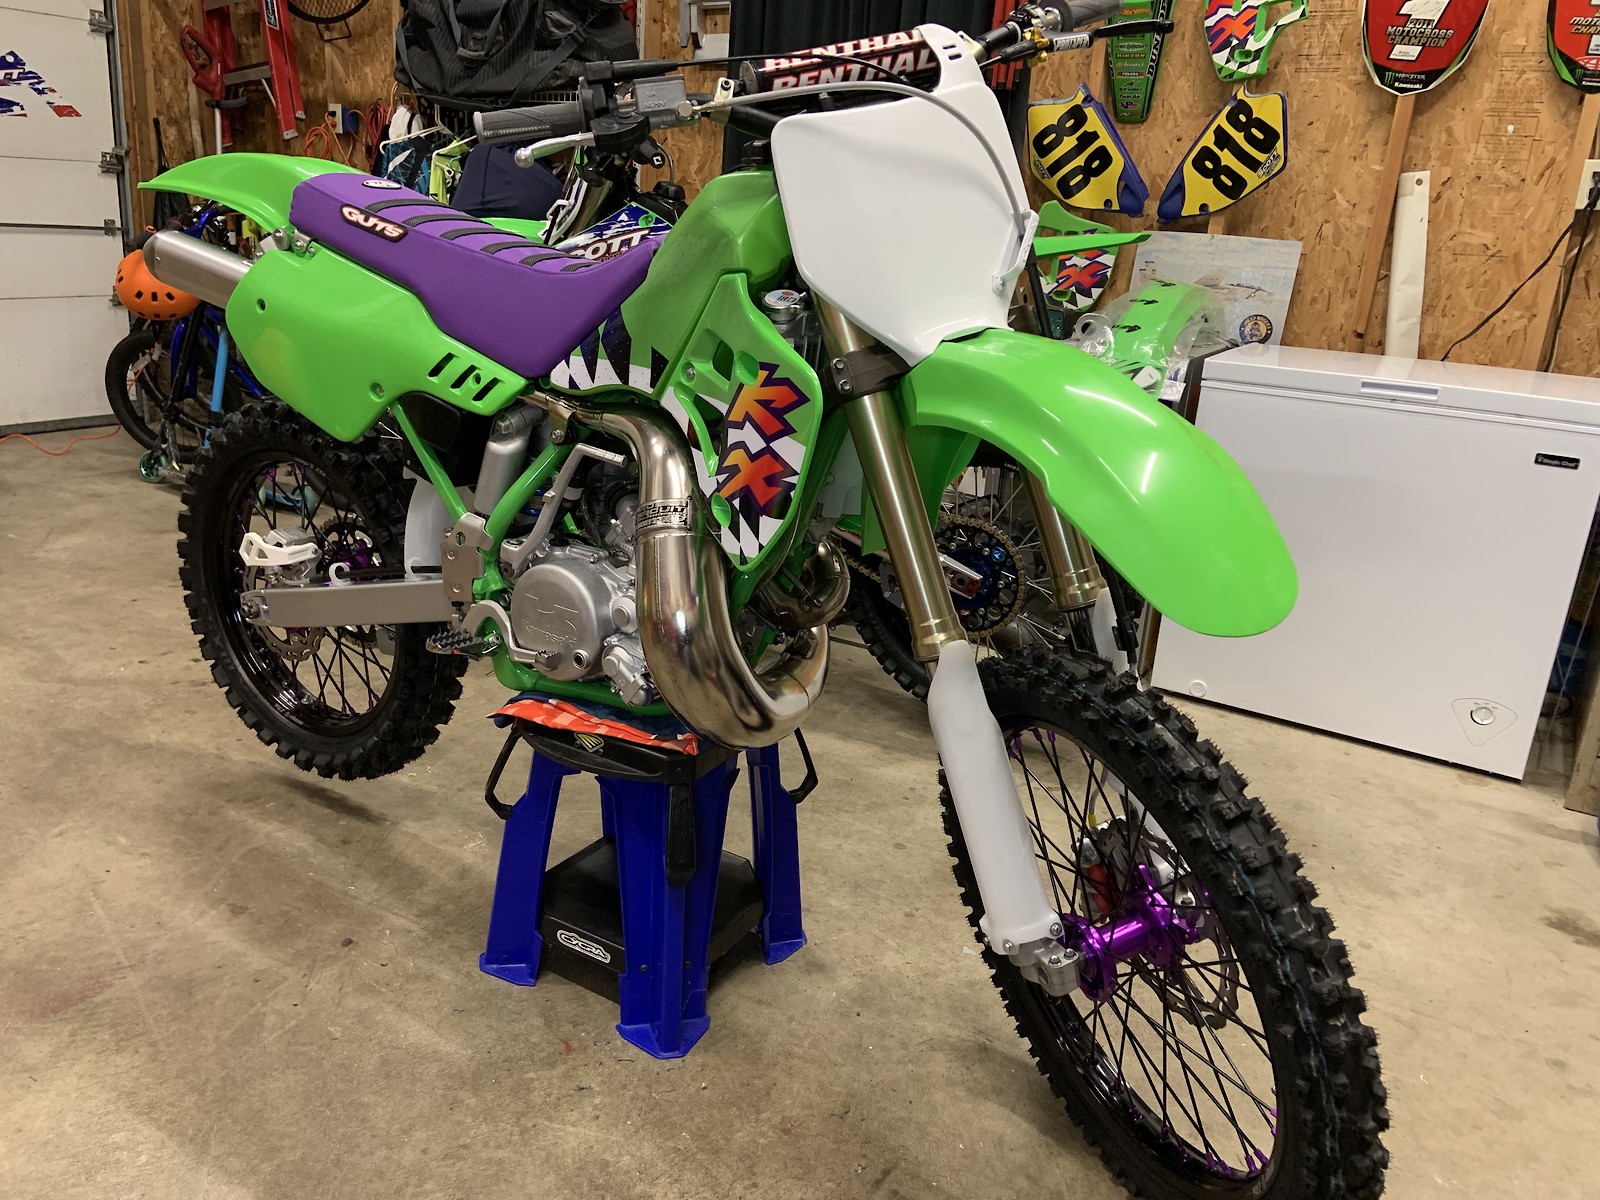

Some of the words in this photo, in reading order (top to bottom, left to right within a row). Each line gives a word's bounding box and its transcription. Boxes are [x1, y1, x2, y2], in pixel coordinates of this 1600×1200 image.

[1386, 26, 1455, 38] MOTOCROSS
[1407, 19, 1436, 28] 2011
[1388, 36, 1447, 47] CHAMPION
[1394, 81, 1422, 89] Kawasaki
[1032, 104, 1113, 200] 818
[1192, 99, 1280, 200] 818
[342, 206, 404, 238] GUTS
[719, 366, 805, 511] KX
